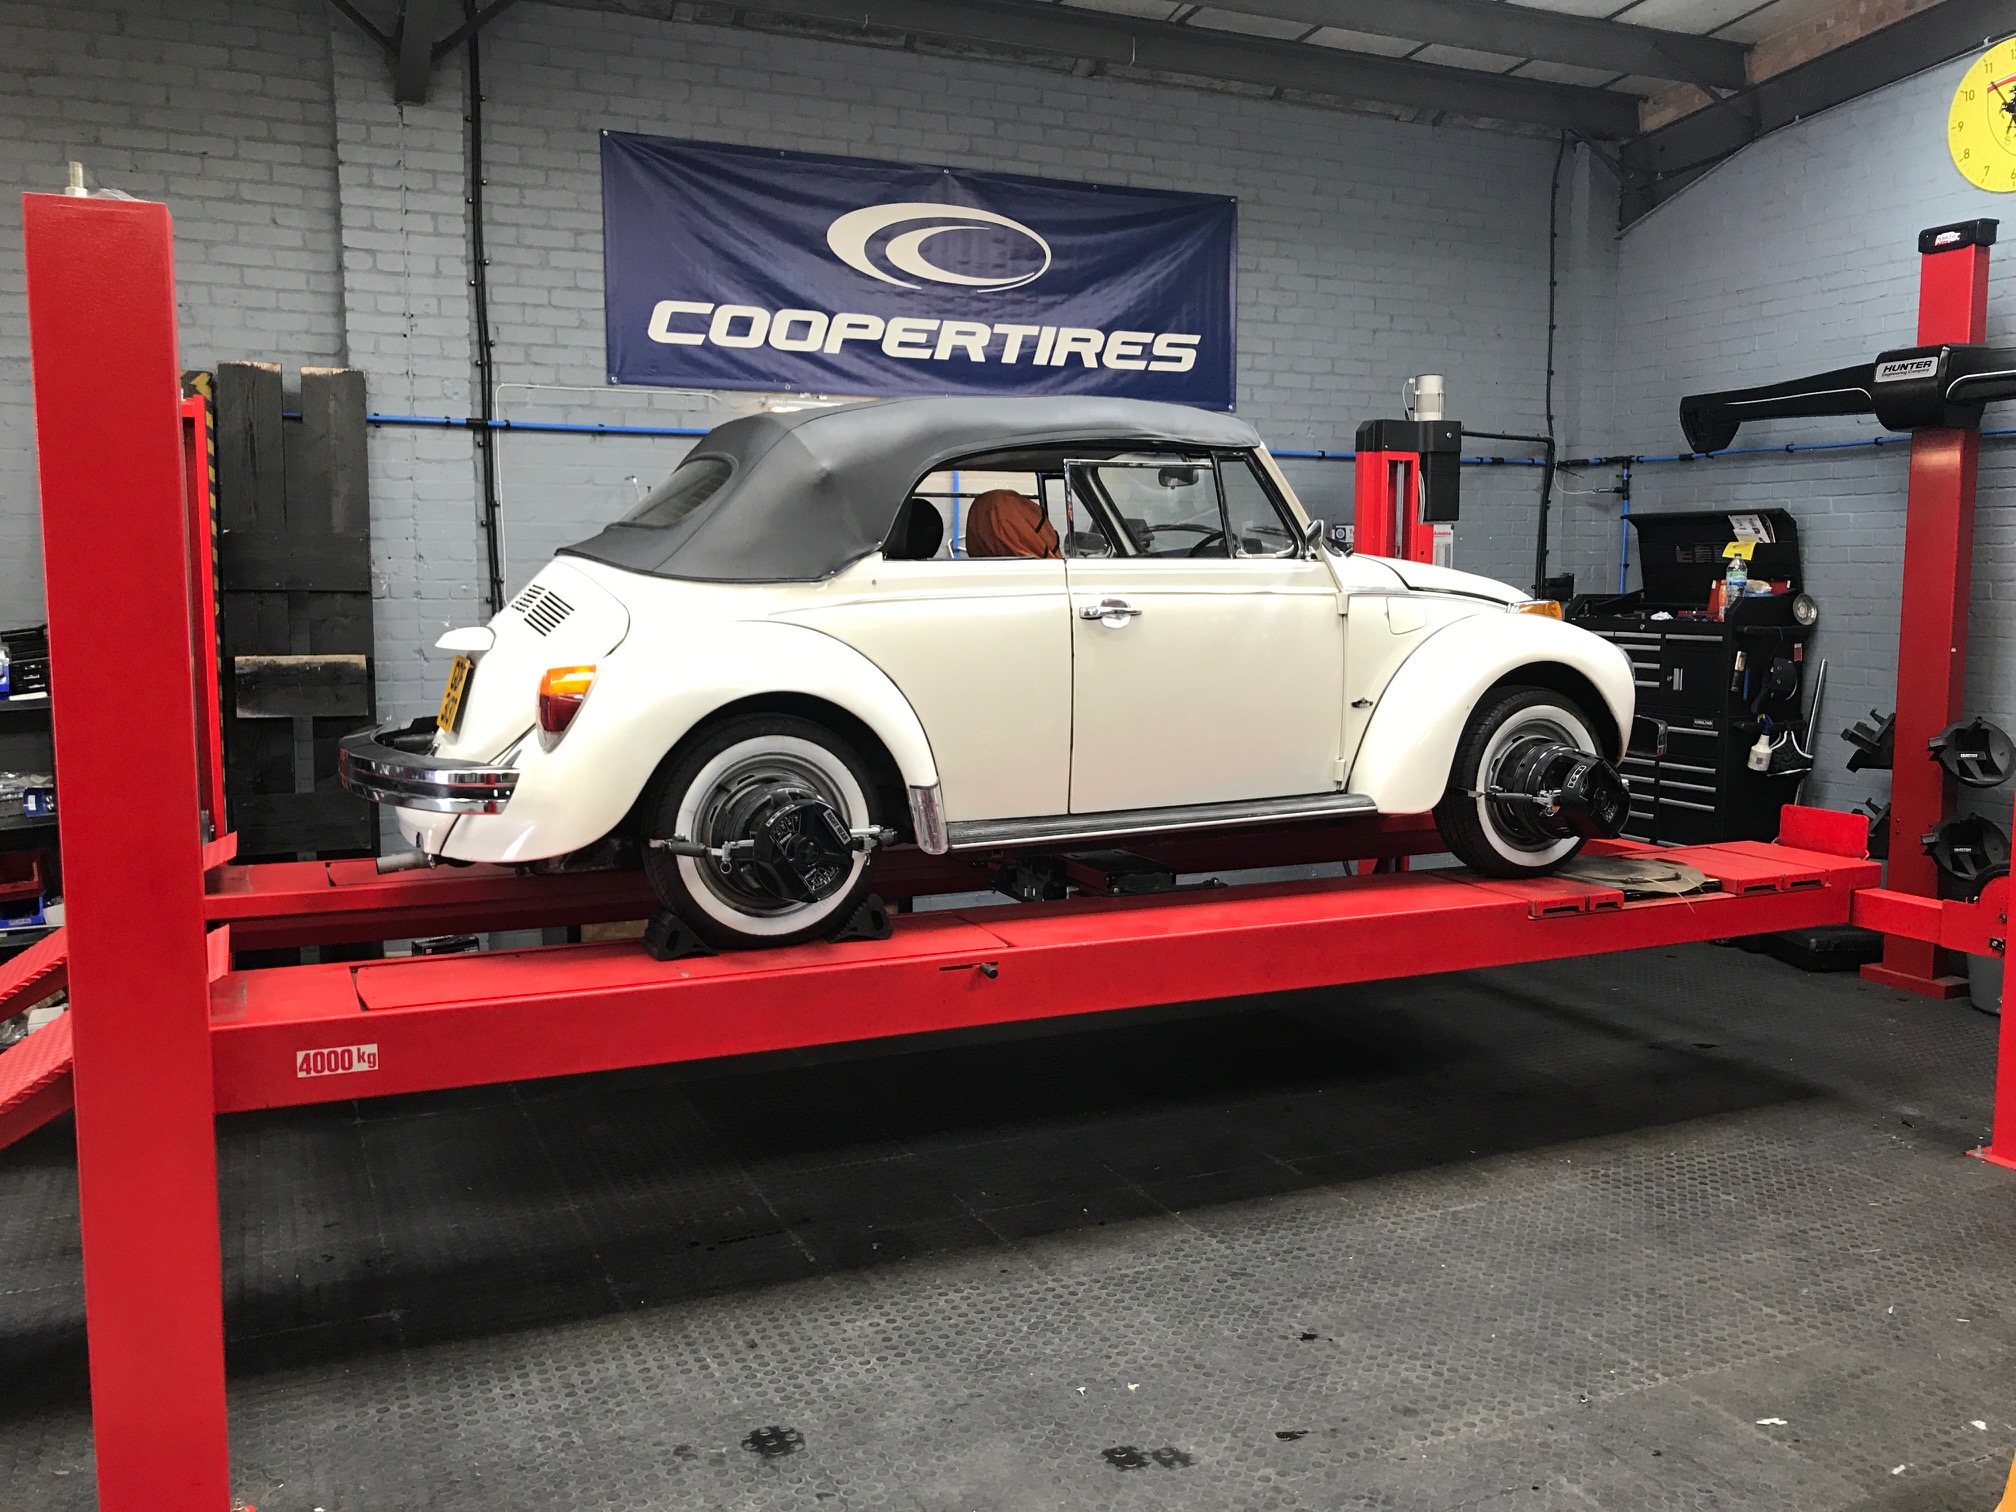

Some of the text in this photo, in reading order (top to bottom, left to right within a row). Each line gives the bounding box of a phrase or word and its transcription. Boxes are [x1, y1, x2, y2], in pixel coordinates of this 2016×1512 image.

[1985, 62, 1993, 74] 11
[1964, 89, 1975, 102] 10
[1957, 121, 1964, 132] 9
[1963, 148, 1970, 159] 8
[1984, 165, 1990, 177] 7
[2010, 168, 2016, 180] 6
[648, 300, 1202, 373] COOPERTIRES
[1883, 360, 1932, 372] HUNTER
[826, 811, 849, 842] RIGHT REAR
[298, 1047, 377, 1075] 4000 kg
